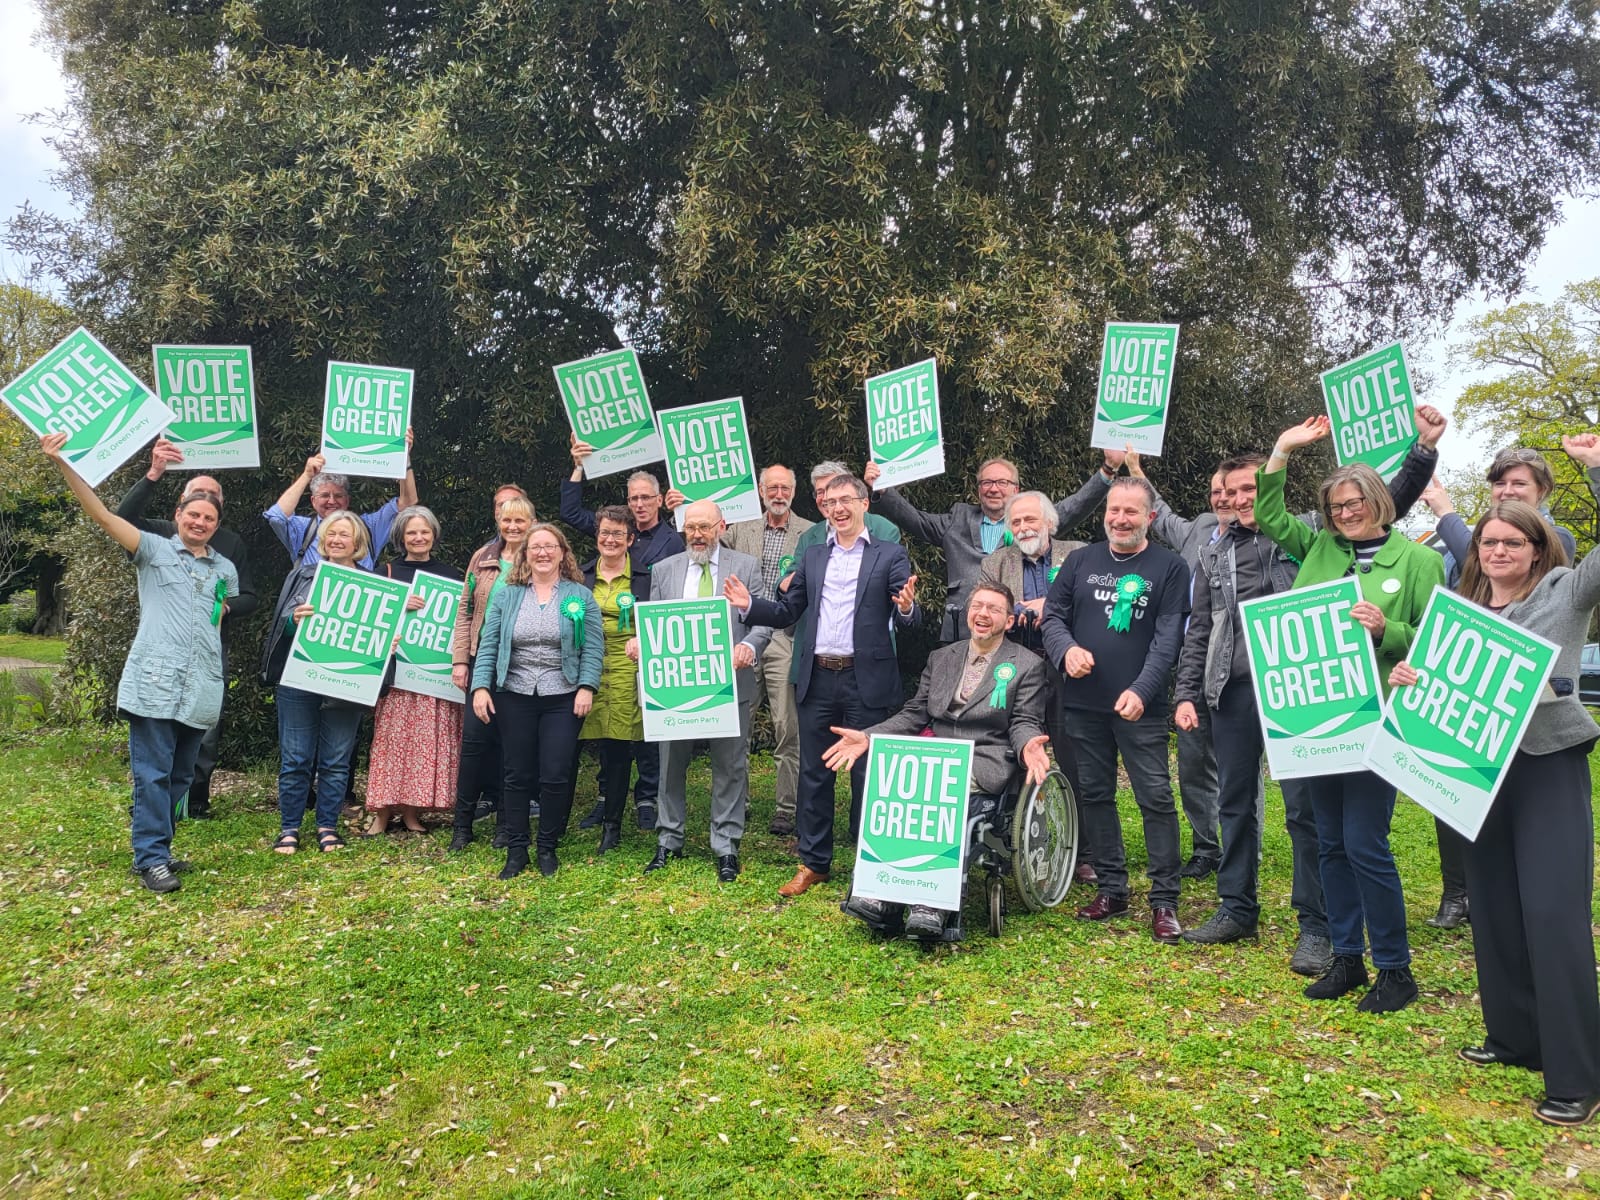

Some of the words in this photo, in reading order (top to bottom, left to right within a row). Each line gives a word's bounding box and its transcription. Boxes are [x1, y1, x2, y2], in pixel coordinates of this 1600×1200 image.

[163, 359, 245, 394] VOTE
[1110, 337, 1170, 376] VOTE
[16, 342, 108, 418] VOTE
[335, 374, 405, 411] VOTE
[564, 361, 638, 408] VOTE
[872, 373, 931, 420] VOTE
[1103, 374, 1164, 407] GREEN
[1331, 359, 1406, 423] VOTE
[45, 370, 131, 441] GREEN
[167, 395, 247, 423] GREEN
[331, 406, 402, 437] GREEN
[576, 395, 646, 435] GREEN
[874, 406, 933, 446] GREEN
[667, 412, 741, 456] VOTE
[1340, 403, 1414, 458] GREEN
[674, 448, 746, 486] GREEN
[319, 576, 399, 629] VOTE
[416, 585, 461, 623] VO
[305, 613, 388, 658] GREEN
[405, 618, 455, 655] GRE
[644, 612, 724, 656] VOTE
[1253, 600, 1359, 667] VOTE
[319, 673, 341, 684] Green
[342, 678, 361, 690] Party
[647, 653, 727, 689] GREEN
[1264, 654, 1369, 710] GREEN
[1424, 611, 1537, 717] VOTE
[677, 717, 699, 725] Green
[700, 716, 720, 724] Party
[1402, 668, 1512, 763] GREEN
[1310, 746, 1338, 755] Green
[1339, 742, 1365, 752] Party
[877, 752, 962, 804] VOTE
[1409, 764, 1435, 786] Green
[1435, 782, 1460, 805] Party
[869, 799, 957, 845] GREEN
[891, 876, 916, 887] Green
[917, 879, 939, 891] Party
